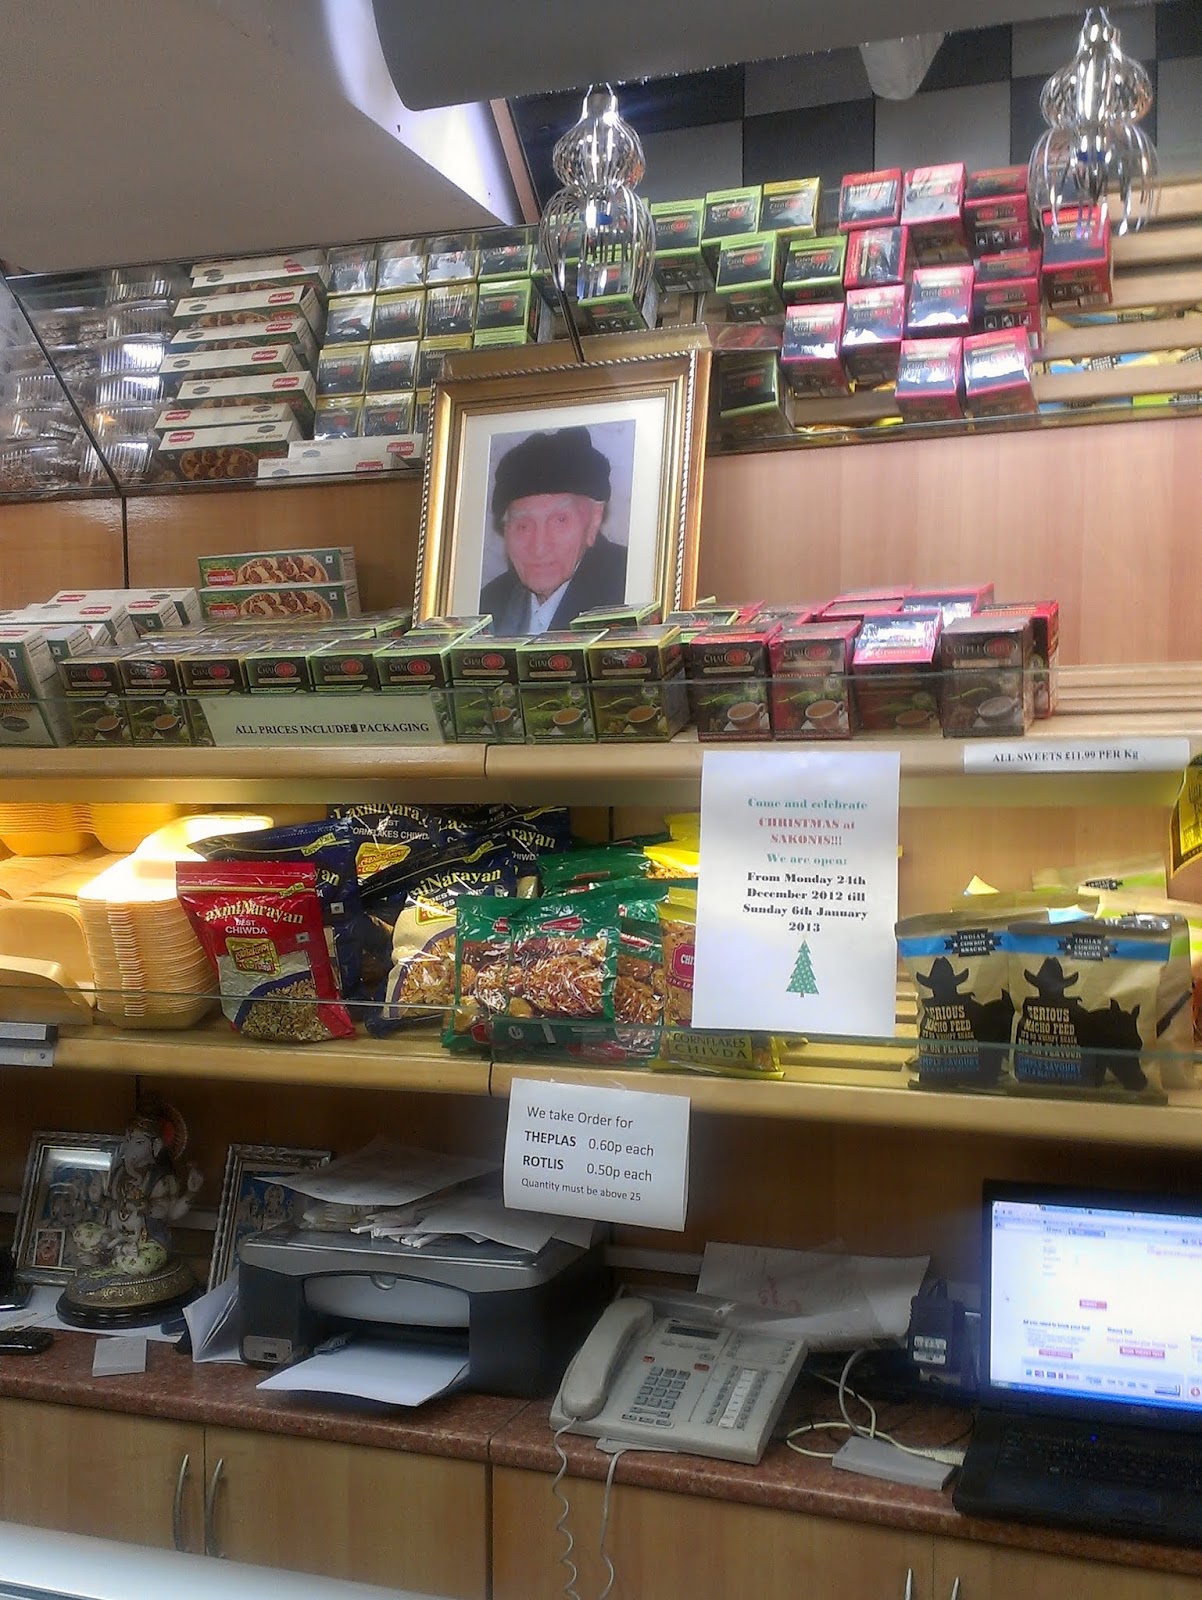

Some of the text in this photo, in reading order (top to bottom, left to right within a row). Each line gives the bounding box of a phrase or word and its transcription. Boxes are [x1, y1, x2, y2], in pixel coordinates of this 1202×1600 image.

[235, 723, 429, 734] ALL PRICES INCLUDE PACKAGING
[992, 753, 1015, 762] ALL
[1017, 752, 1062, 762] SWEETS
[1065, 751, 1096, 761] £11.99
[1099, 750, 1121, 759] PER
[748, 798, 868, 811] Come and celebrate
[758, 818, 856, 830] CHRISTMAS at
[350, 826, 430, 841] ORNFLAKES CHIWD
[770, 834, 843, 845] SAKONIS!!!
[767, 853, 847, 867] We are open:
[747, 872, 867, 887] From Monday 24th
[747, 888, 866, 902] December 2012 till
[743, 904, 868, 921] Sunday 6th January
[225, 926, 268, 935] CHIWDA
[788, 921, 821, 933] 2013
[950, 1018, 971, 1032] FEED
[1053, 1023, 1075, 1036] FEED
[673, 1032, 746, 1048] CORNFLAKES
[675, 1045, 748, 1059] CHIVDA
[527, 1106, 633, 1129] We take Order for
[525, 1130, 654, 1156] THEPLAS 0.60p each
[523, 1155, 652, 1181] ROTLIS 0.50p each
[521, 1178, 641, 1201] Quantity must be above 25
